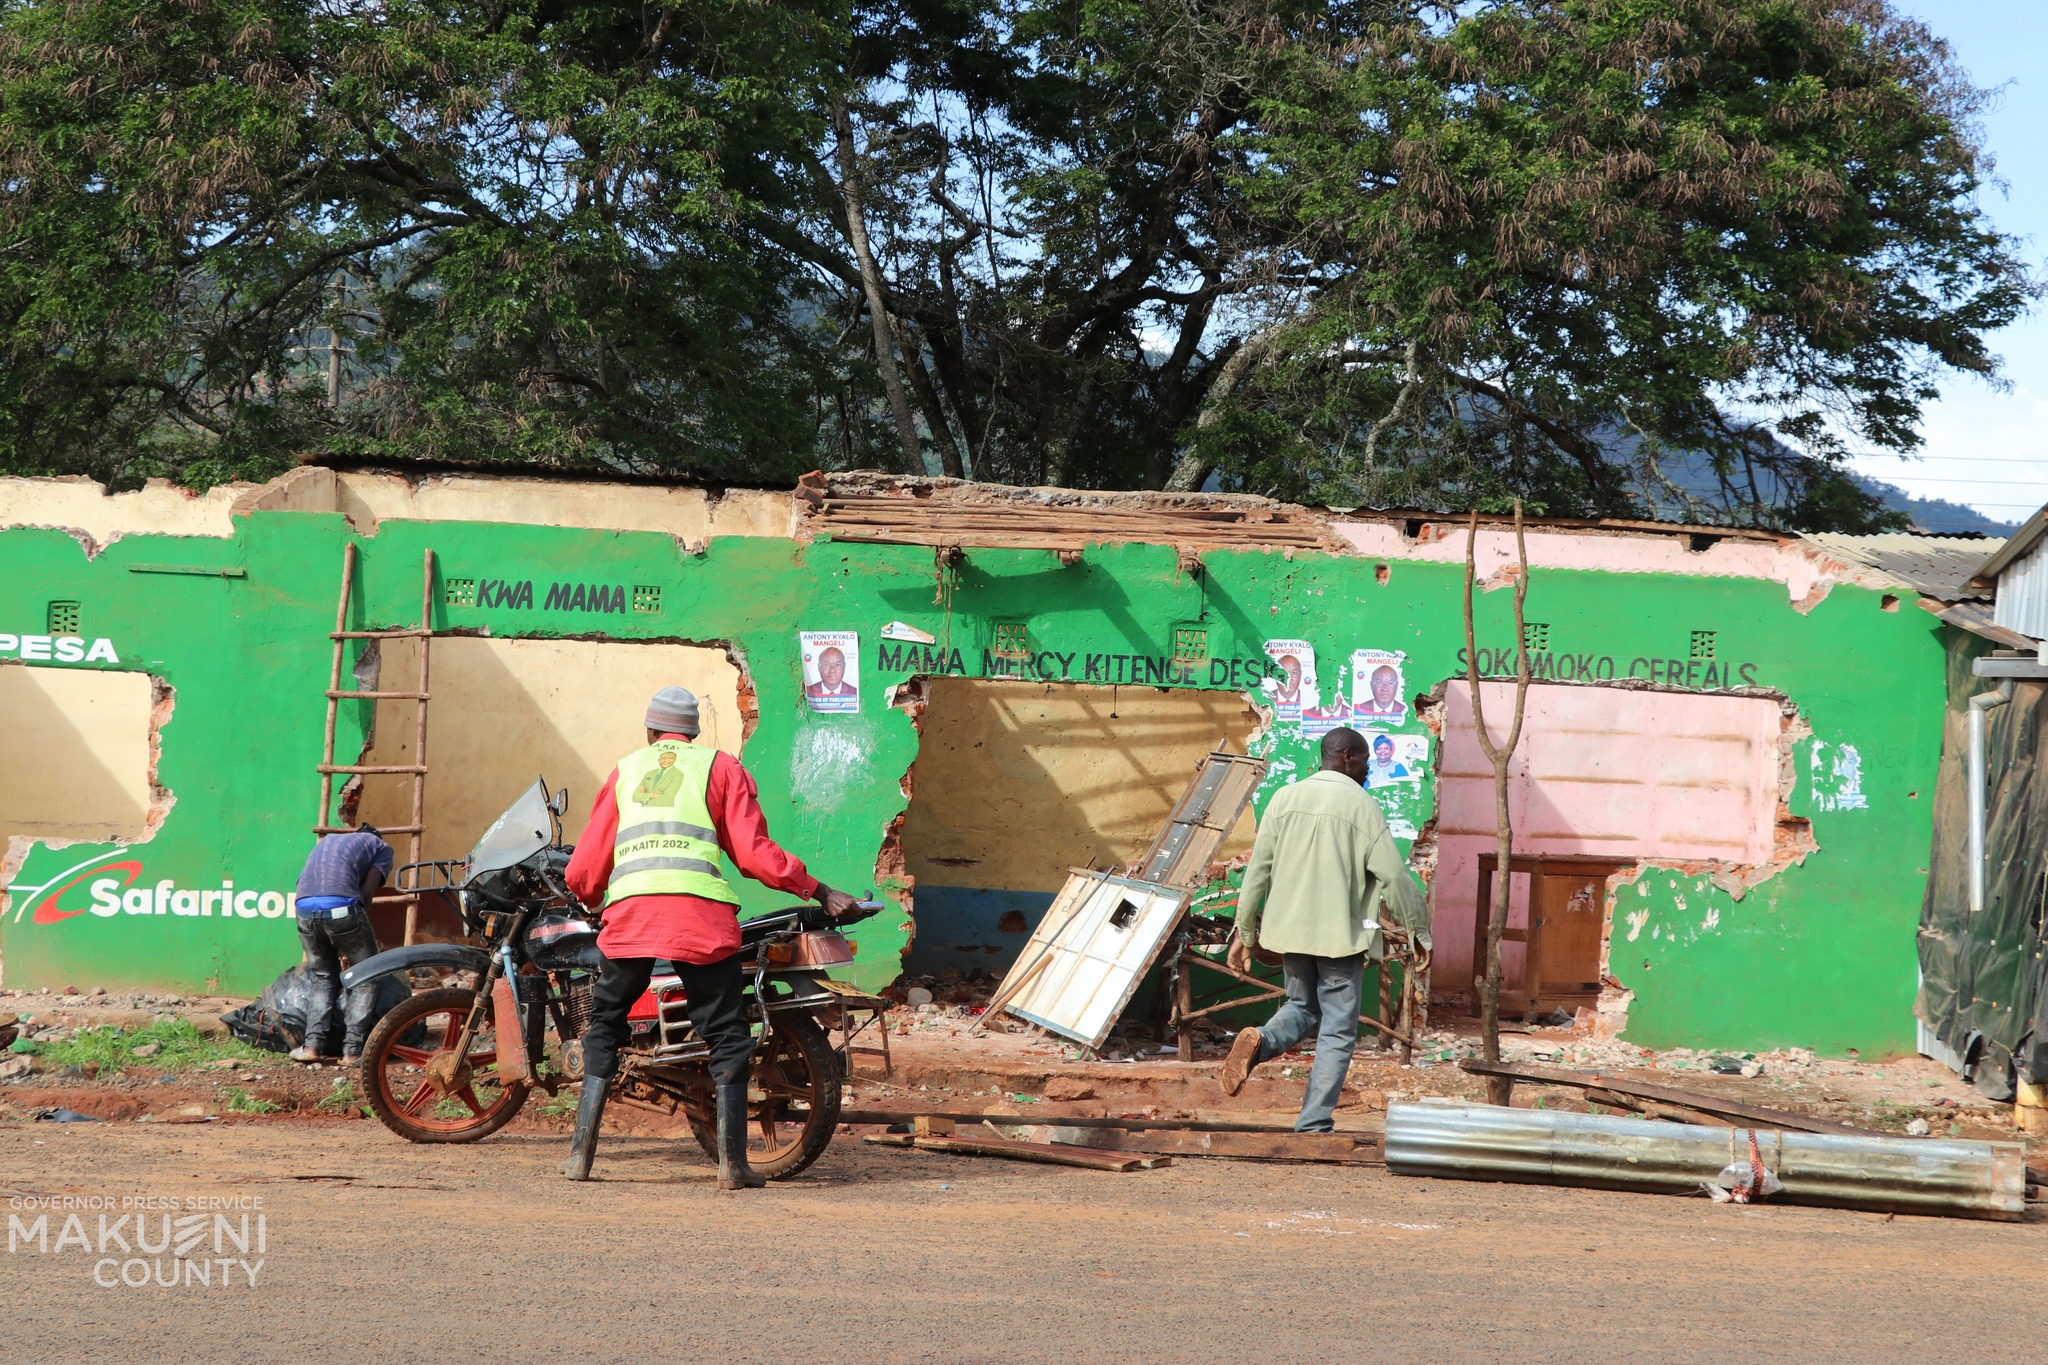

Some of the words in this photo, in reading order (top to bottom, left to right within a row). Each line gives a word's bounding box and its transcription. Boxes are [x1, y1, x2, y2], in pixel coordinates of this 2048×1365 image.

[476, 579, 533, 610] KWA
[544, 582, 625, 614] MAMA
[878, 644, 966, 675] MAMA
[982, 648, 1076, 679] MERCY
[1085, 653, 1197, 685] KITENGE
[1629, 657, 1758, 689] CEREALS
[618, 846, 630, 858] MP
[631, 840, 659, 853] KAITI
[662, 840, 690, 850] 2022
[89, 878, 297, 918] Safarico
